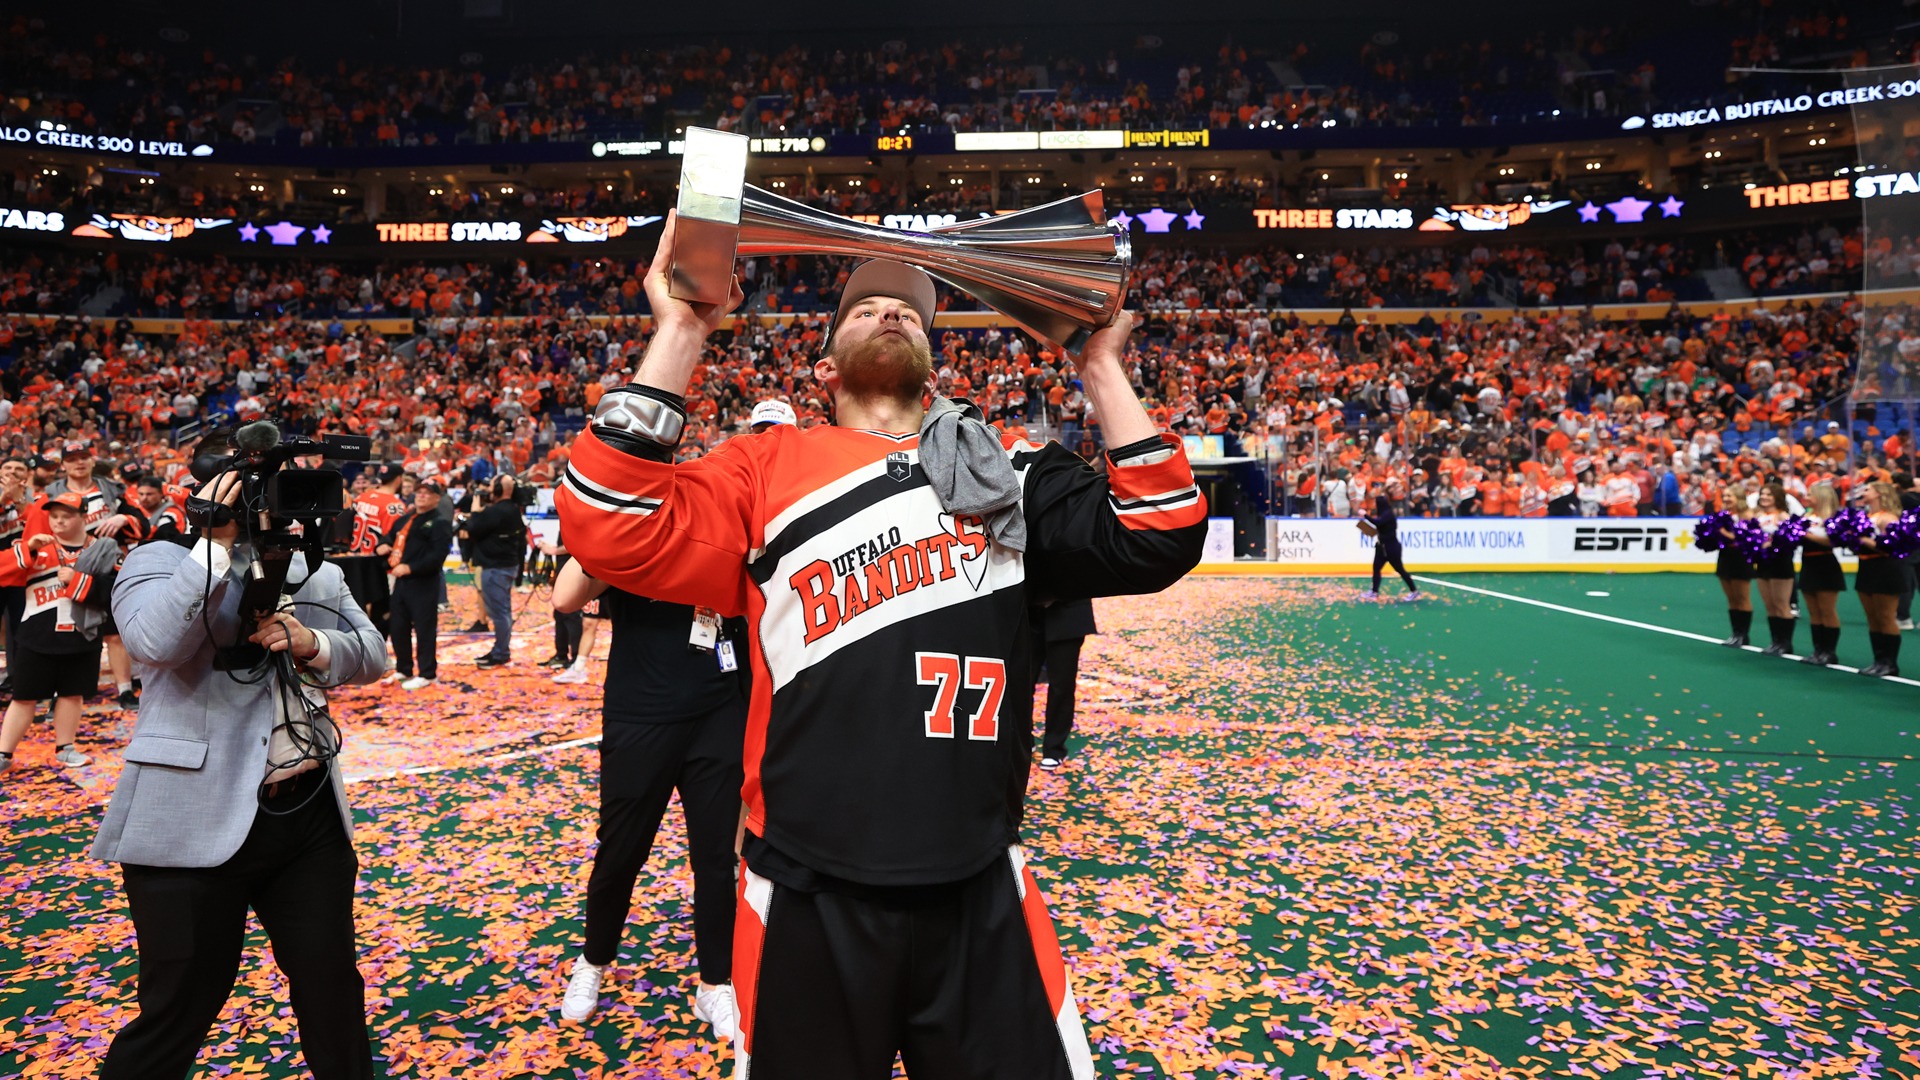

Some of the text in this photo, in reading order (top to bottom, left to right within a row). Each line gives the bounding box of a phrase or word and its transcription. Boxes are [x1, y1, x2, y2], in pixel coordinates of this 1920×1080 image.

[1652, 107, 1720, 129] SENECA
[1725, 95, 1812, 121] BUFFALO
[1817, 84, 1884, 108] CREEK
[36, 131, 94, 149] CREEK
[98, 136, 134, 152] 300
[139, 140, 187, 156] LEVEL
[782, 138, 810, 152] 716
[878, 136, 912, 150] 10:27
[1131, 132, 1163, 142] HUNT
[1170, 131, 1202, 142] HUNT
[1744, 172, 1920, 208] THREE STA
[884, 214, 956, 232] STARS
[1253, 208, 1413, 229] THREE STARS
[376, 222, 521, 242] THREE STARS
[887, 452, 908, 461] NLL
[1400, 531, 1475, 548] MSTERDAM
[1480, 531, 1525, 548] VODKA
[789, 514, 987, 648] BANDITS
[915, 651, 1006, 741] 77
